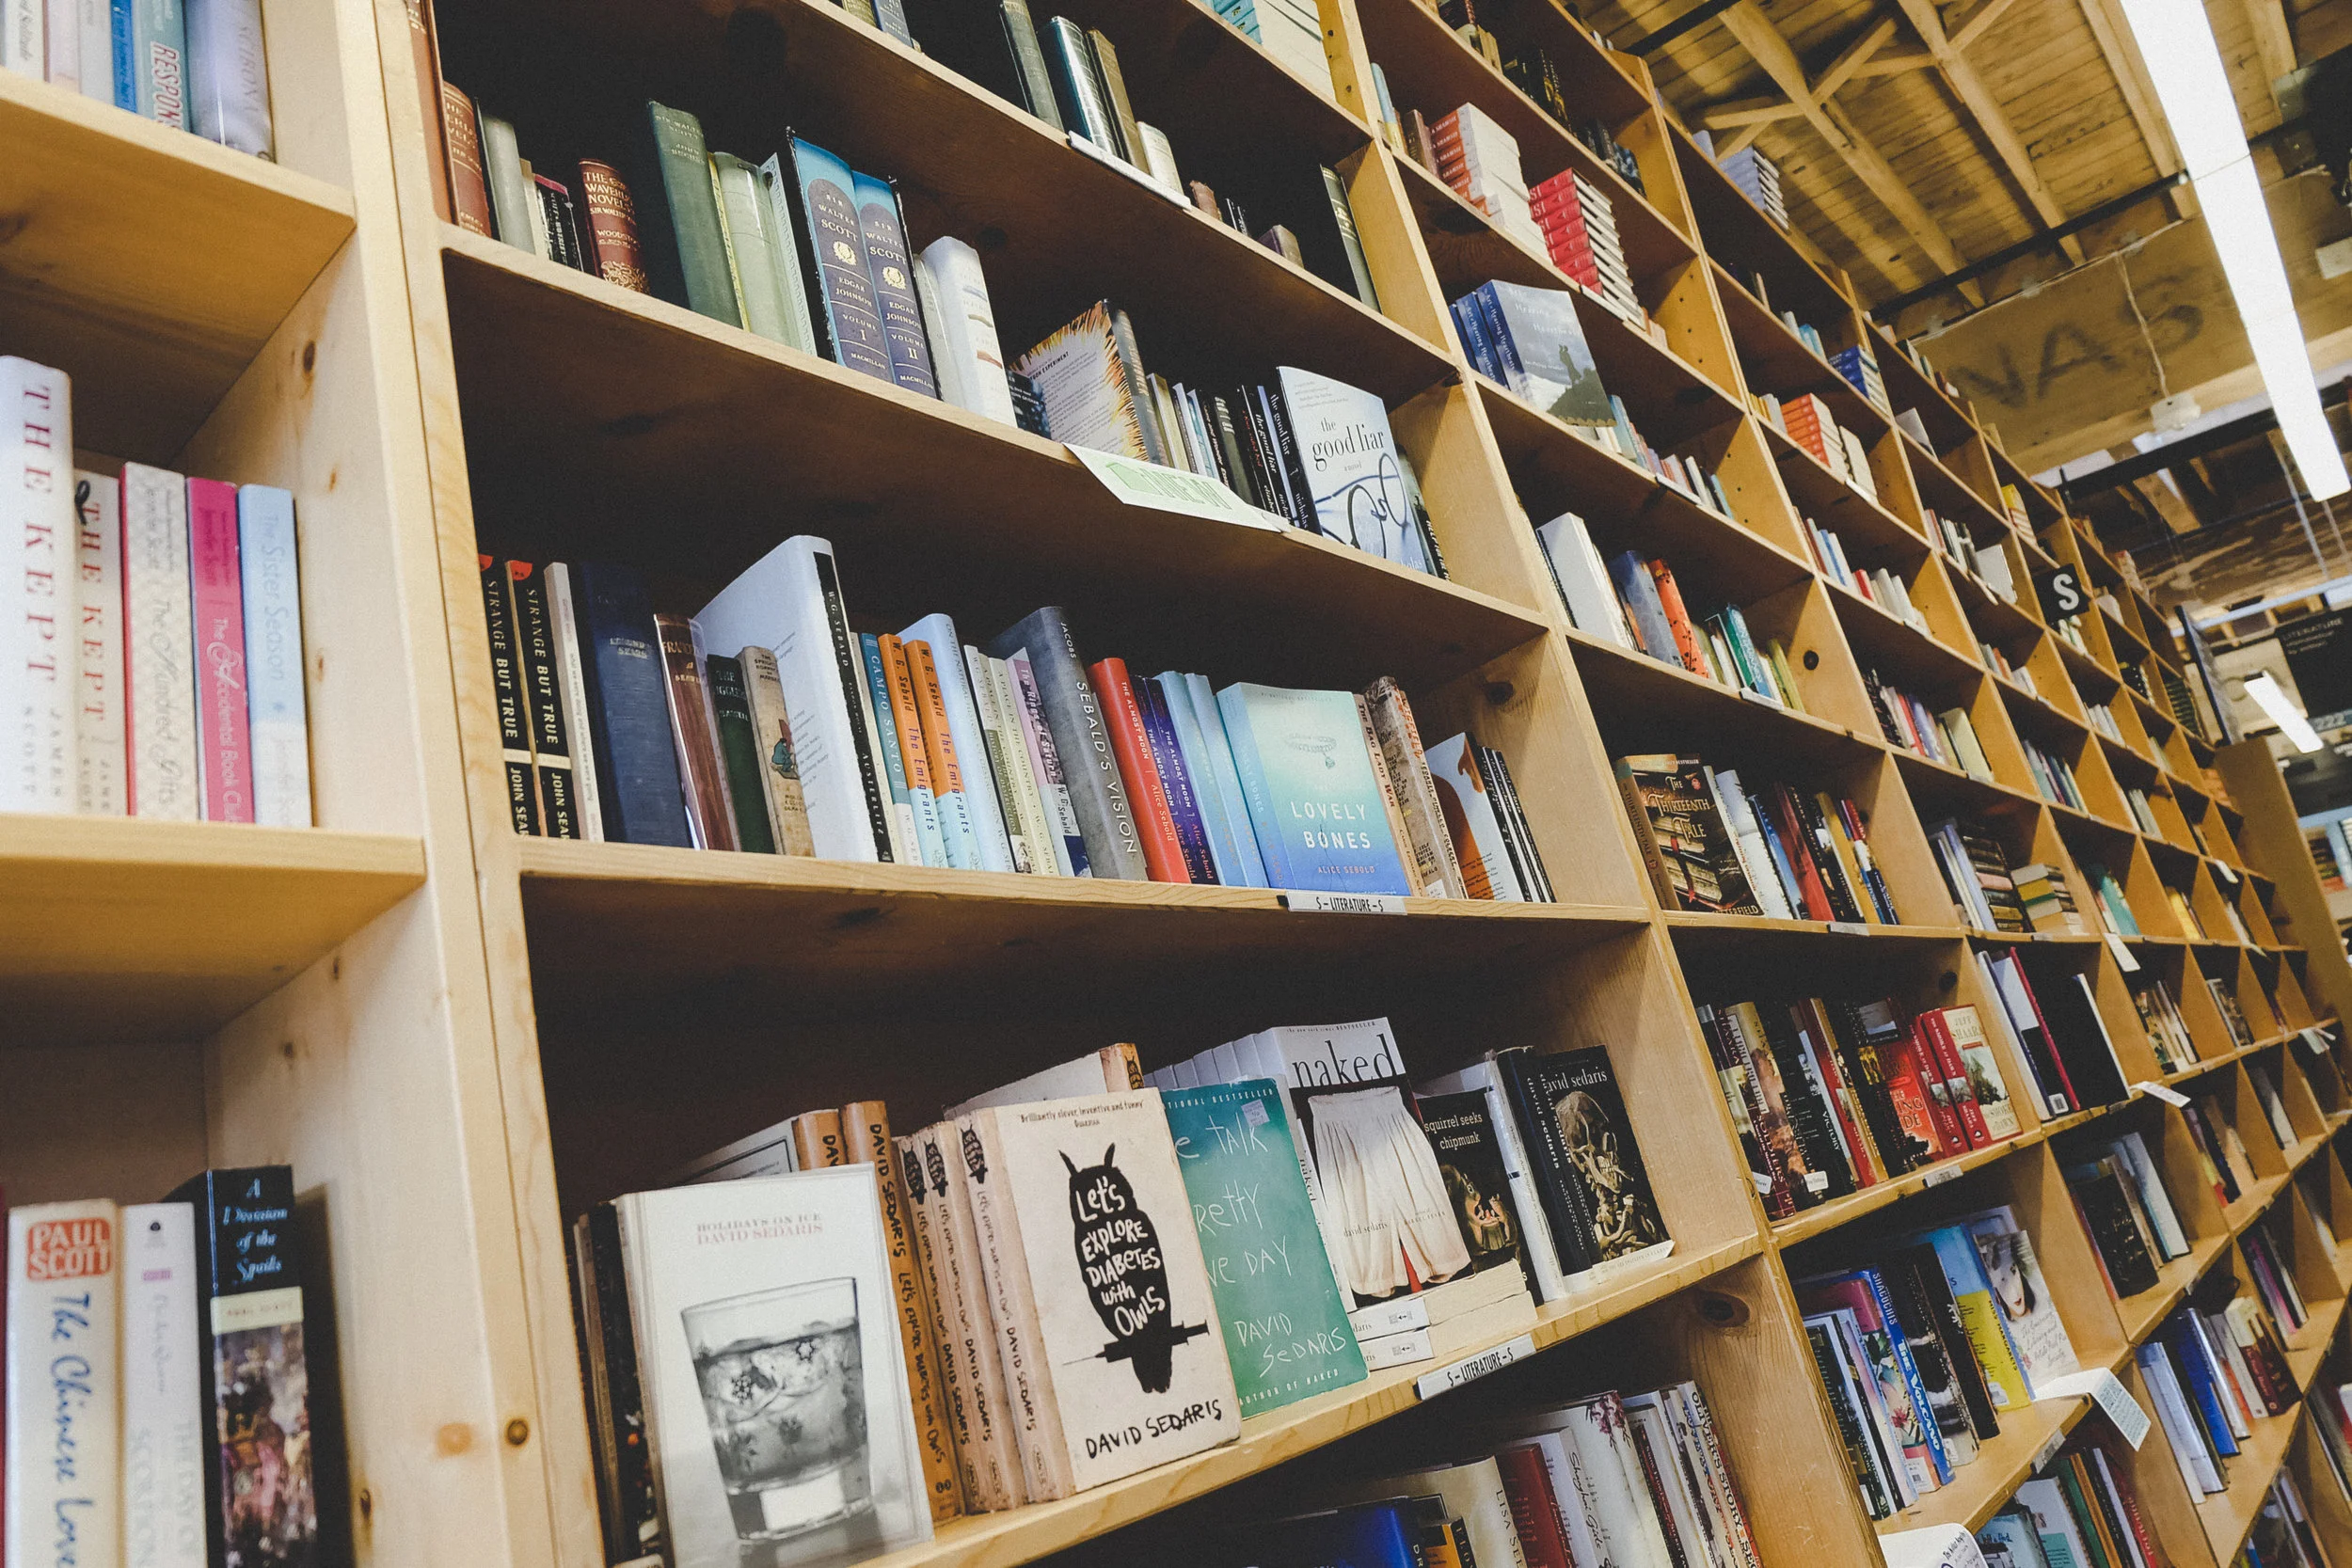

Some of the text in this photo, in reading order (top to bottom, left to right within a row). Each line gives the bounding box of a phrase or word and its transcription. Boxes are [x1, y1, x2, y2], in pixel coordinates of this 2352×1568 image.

[586, 172, 608, 184] THE
[818, 203, 855, 227] WALTER
[826, 194, 844, 208] SIR
[820, 218, 859, 243] SCOTT
[874, 220, 893, 231] SIR
[869, 245, 907, 265] SCOTT
[835, 287, 873, 308] JOHNSON
[839, 277, 866, 293] EDGAR
[842, 313, 878, 332] VOLUME
[889, 301, 915, 315] EDGAR
[850, 352, 886, 370] MACMILLAN
[1270, 394, 1290, 455] the good liar
[1320, 416, 1337, 435] the
[1312, 423, 1385, 472] good liar
[24, 385, 56, 682] THE KEPT
[81, 502, 104, 721] THE KEPT
[2053, 573, 2079, 611] S
[213, 618, 230, 642] The
[262, 544, 292, 681] Sister Season
[486, 580, 518, 738] STRANGE BUT TRUE
[1060, 622, 1077, 659] JACOBS
[527, 588, 558, 744] STRANGE BUT TRUE
[871, 655, 902, 773] CAMPO SANTO
[1120, 681, 1150, 760] THE ALMOST MOON
[893, 641, 935, 832] W. G. Sebald The Emigrants
[920, 648, 970, 835] W. G. Sebald The Emigrants
[1359, 705, 1395, 808] THE BAG LADY WAR
[221, 749, 240, 787] Book
[1041, 739, 1057, 779] Saturn
[1076, 681, 1138, 854] SEBALD'S VISION
[1147, 728, 1175, 807] THE ALMOST MOON
[1164, 730, 1192, 808] THE ALMOST MOON
[510, 768, 522, 797] JOHN
[551, 772, 565, 806] JOHN
[862, 753, 883, 835] AUSTERLITZ
[1664, 775, 1684, 791] THE
[1151, 784, 1175, 842] Alice Sebold
[1291, 800, 1365, 820] LOVELY
[1647, 793, 1711, 817] THIRTEENTH
[1303, 831, 1371, 849] BONES
[1672, 816, 1707, 845] TALE
[1175, 823, 1198, 879] Alice Sebold
[1192, 822, 1214, 880] Alice Sebold
[1318, 866, 1375, 875] ALICE SEBOLD
[1329, 897, 1372, 911] LITERATURE
[1292, 1032, 1401, 1088] naked
[1570, 1067, 1608, 1087] sedaris
[1110, 1101, 1125, 1112] and
[1213, 1087, 1274, 1103] BESTSELLER
[1423, 1111, 1484, 1134] squirrel seeks
[1438, 1131, 1482, 1151] chipmunk
[1526, 1077, 1560, 1169] david sedaris
[1554, 1115, 1571, 1164] sedaris
[1822, 1110, 1841, 1151] VICTORY
[869, 1123, 907, 1258] DAVID SEDARIS
[1074, 1176, 1125, 1224] Let's
[32, 1220, 111, 1249] PAUL
[237, 1229, 278, 1253] of the
[696, 1212, 821, 1233] HOLIDAYS ON ICE
[696, 1223, 824, 1246] DAVID SEDARIS
[1081, 1218, 1149, 1262] EXPLORE
[1343, 1220, 1390, 1238] david sedaris
[28, 1244, 112, 1279] SCOTT
[1245, 1235, 1293, 1277] DAY
[1101, 1279, 1136, 1307] with
[1113, 1285, 1167, 1337] OWLS
[1871, 1272, 1899, 1326] SHACOCHIS
[1234, 1311, 1293, 1347] DAVID
[51, 1291, 92, 1482] The Chinese
[1005, 1326, 1037, 1433] DAVID SEDARIS
[1447, 1347, 1514, 1387] S LITERATURE S
[943, 1342, 971, 1447] DAVID SEDARIS
[965, 1338, 993, 1443] DAVID SEDARIS
[1239, 1369, 1340, 1406] AUTHOR OF NAKED
[1897, 1338, 1941, 1451] THE VOLCANO
[1085, 1398, 1223, 1460] DAVID SEDARIS
[1691, 1391, 1742, 1537] OLIVER'S STORY
[1495, 1489, 1511, 1529] LISA
[1568, 1451, 1602, 1550] Shanghai Girls
